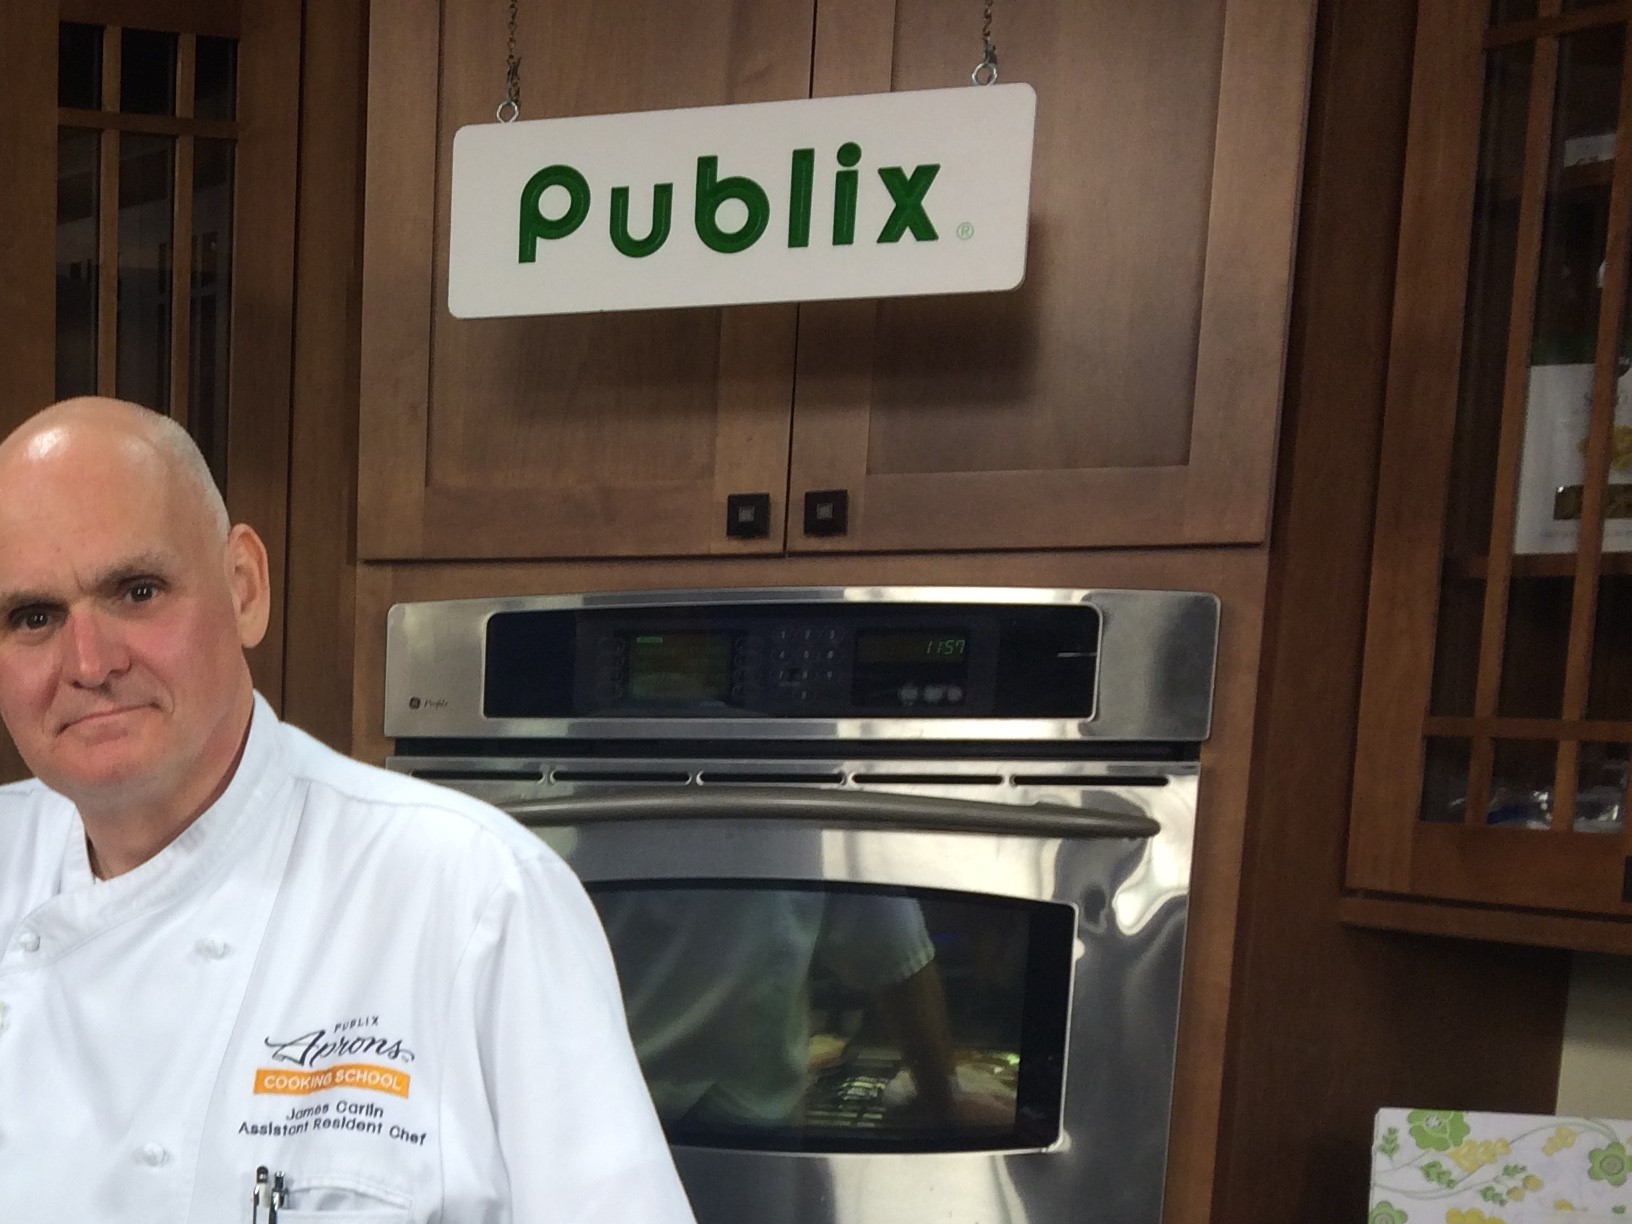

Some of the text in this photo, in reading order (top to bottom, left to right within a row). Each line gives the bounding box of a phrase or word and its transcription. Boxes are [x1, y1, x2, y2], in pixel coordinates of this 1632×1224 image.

[518, 141, 941, 264] Publix
[334, 1015, 379, 1032] PUBLIX
[264, 1029, 415, 1068] Aprons
[264, 1068, 402, 1091] COOKING SCHOOL
[286, 1100, 384, 1121] James Carlin
[238, 1117, 427, 1146] Assistant Resident Chef
